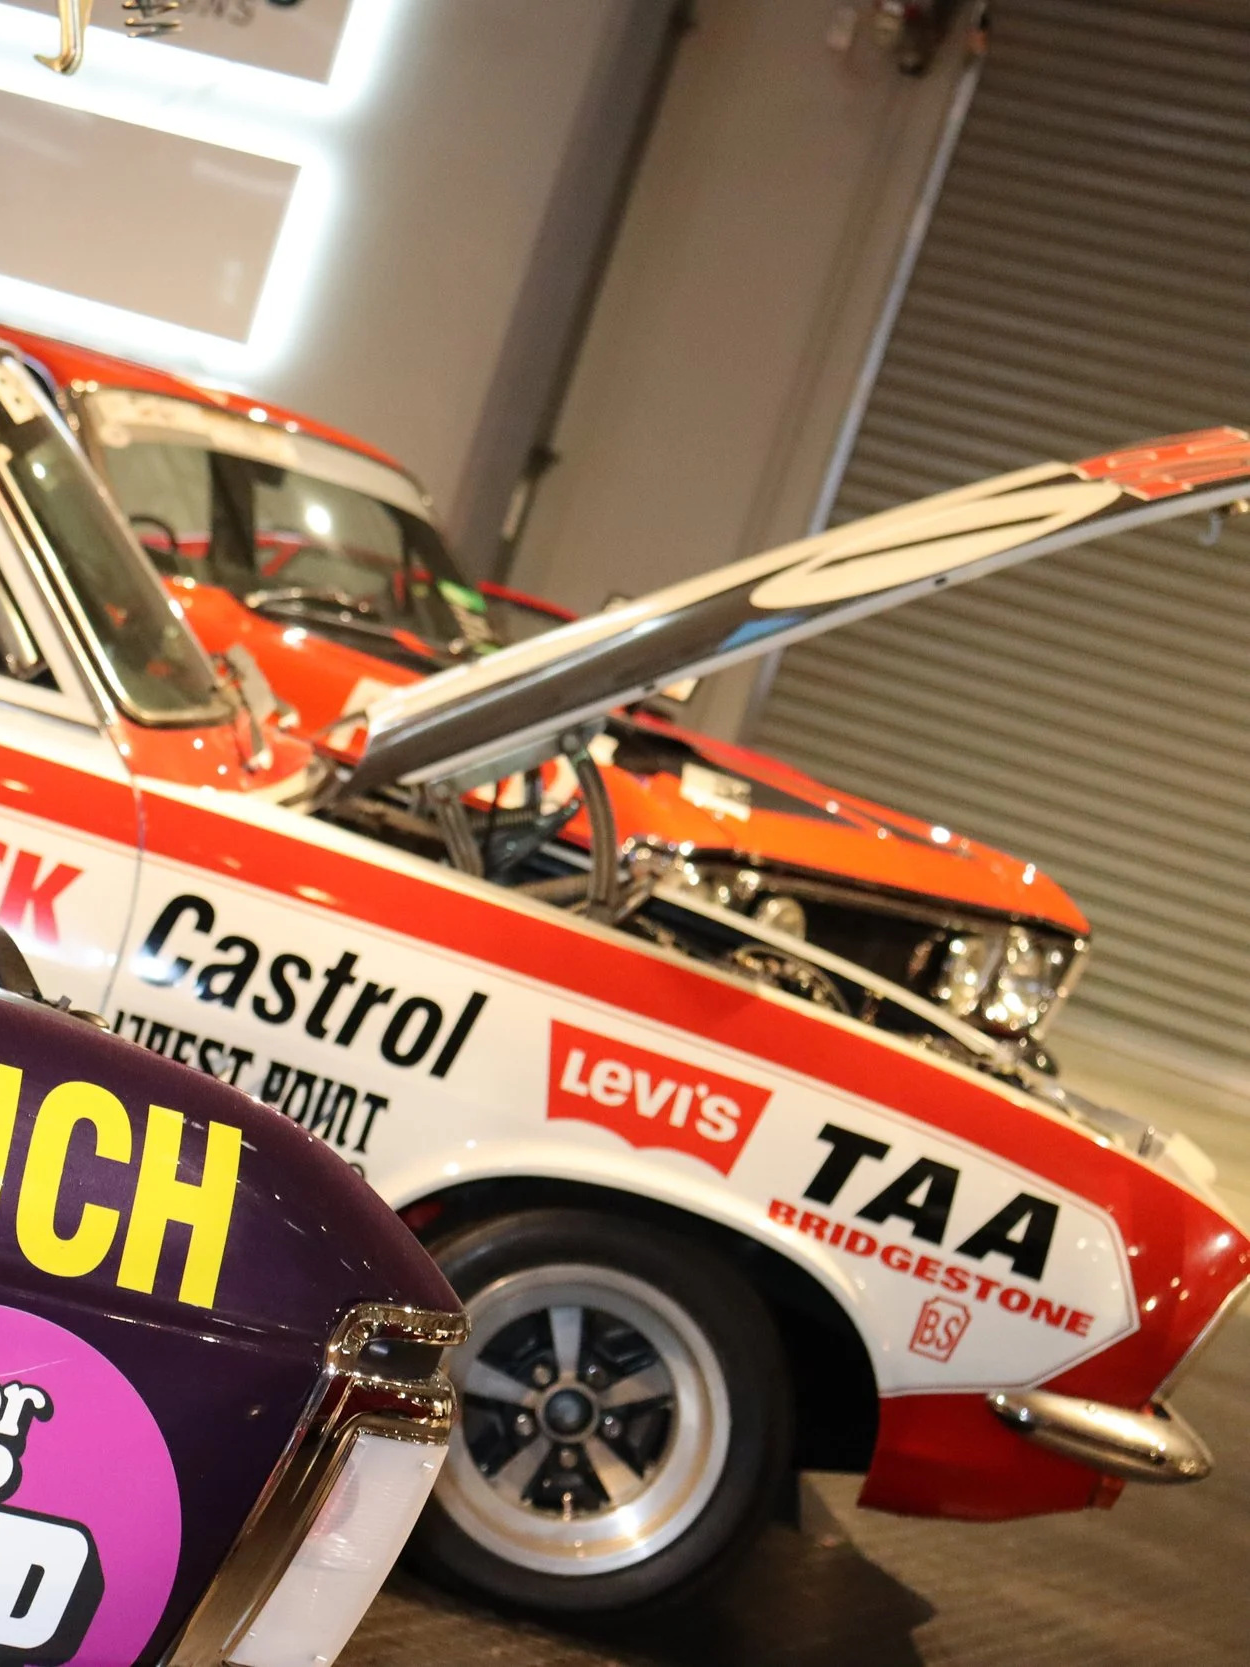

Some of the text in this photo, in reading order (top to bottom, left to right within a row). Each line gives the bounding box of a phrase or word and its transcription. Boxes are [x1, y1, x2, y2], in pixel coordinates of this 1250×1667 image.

[137, 894, 489, 1079] Castrol
[260, 1060, 390, 1154] POINT
[767, 1199, 1095, 1337] BRIDGESTONE
[803, 1123, 1059, 1281] TAA
[920, 1302, 963, 1352] BS
